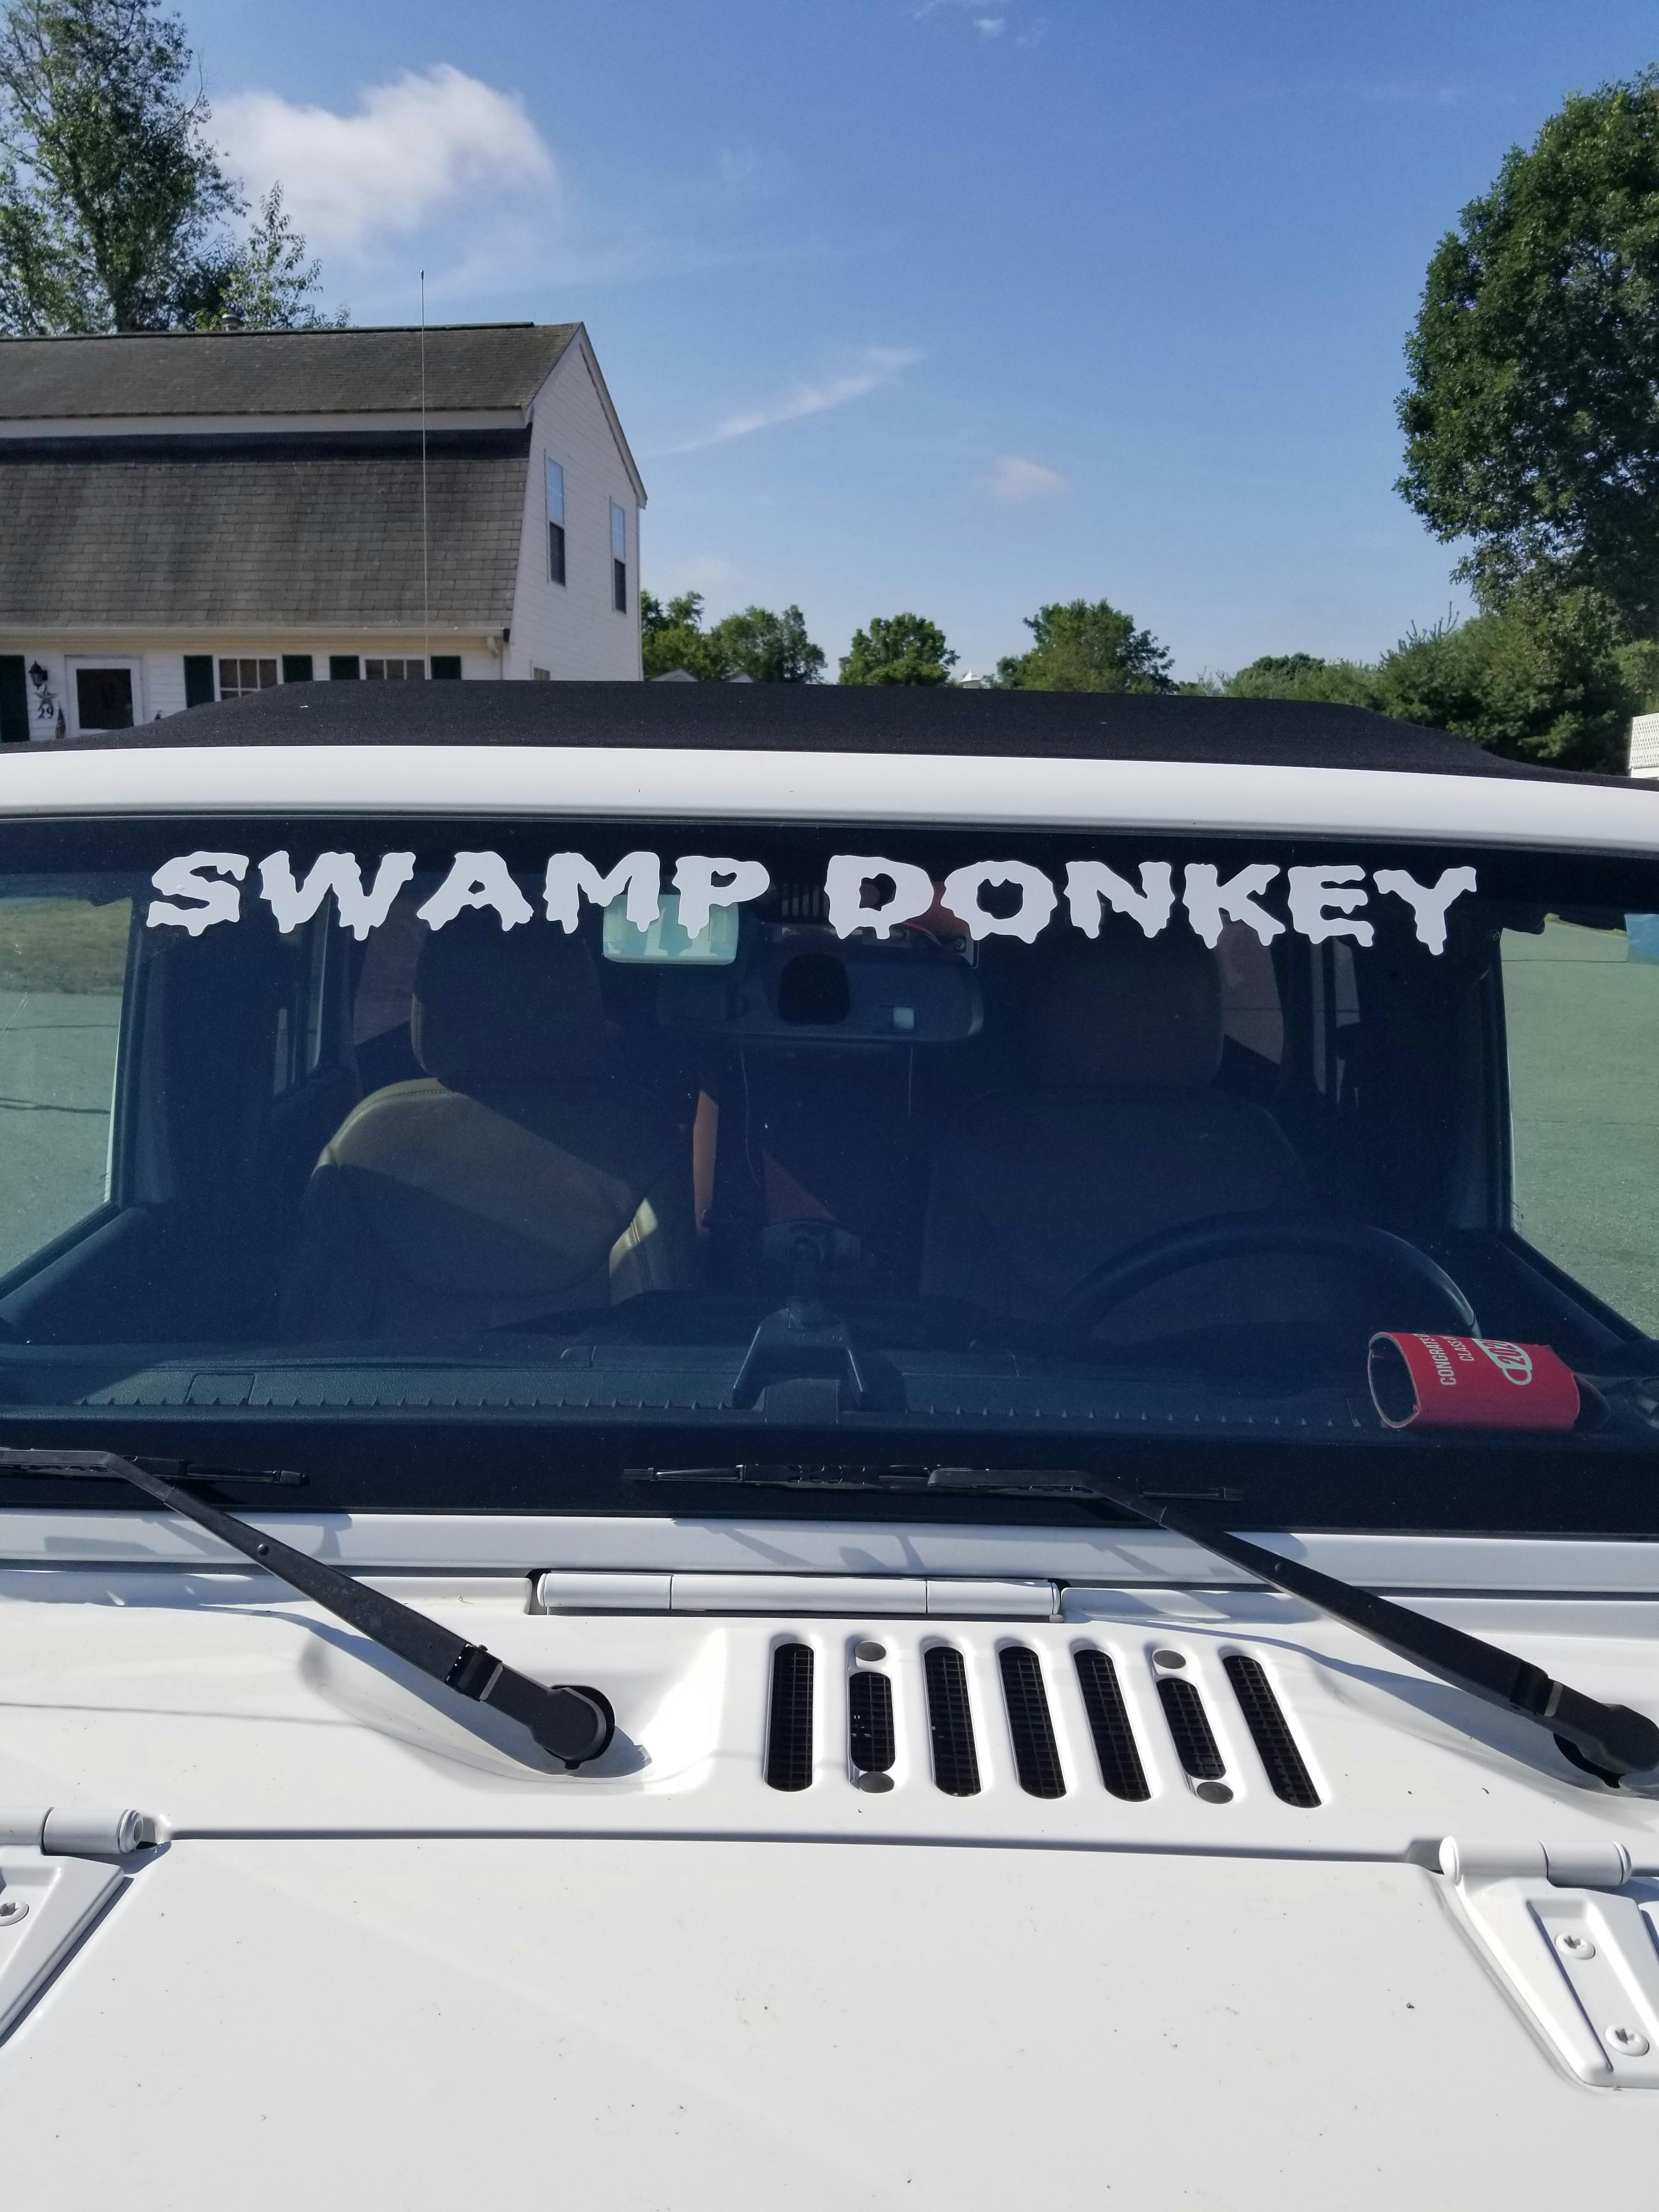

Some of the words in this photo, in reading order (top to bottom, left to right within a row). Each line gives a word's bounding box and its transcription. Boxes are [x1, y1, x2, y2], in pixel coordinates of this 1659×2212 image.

[38, 706, 54, 719] 29
[146, 850, 770, 940] SWAMP
[824, 855, 1476, 955] DONKEY
[1419, 1336, 1457, 1385] CONGRATS
[1447, 1339, 1474, 1361] CLASS
